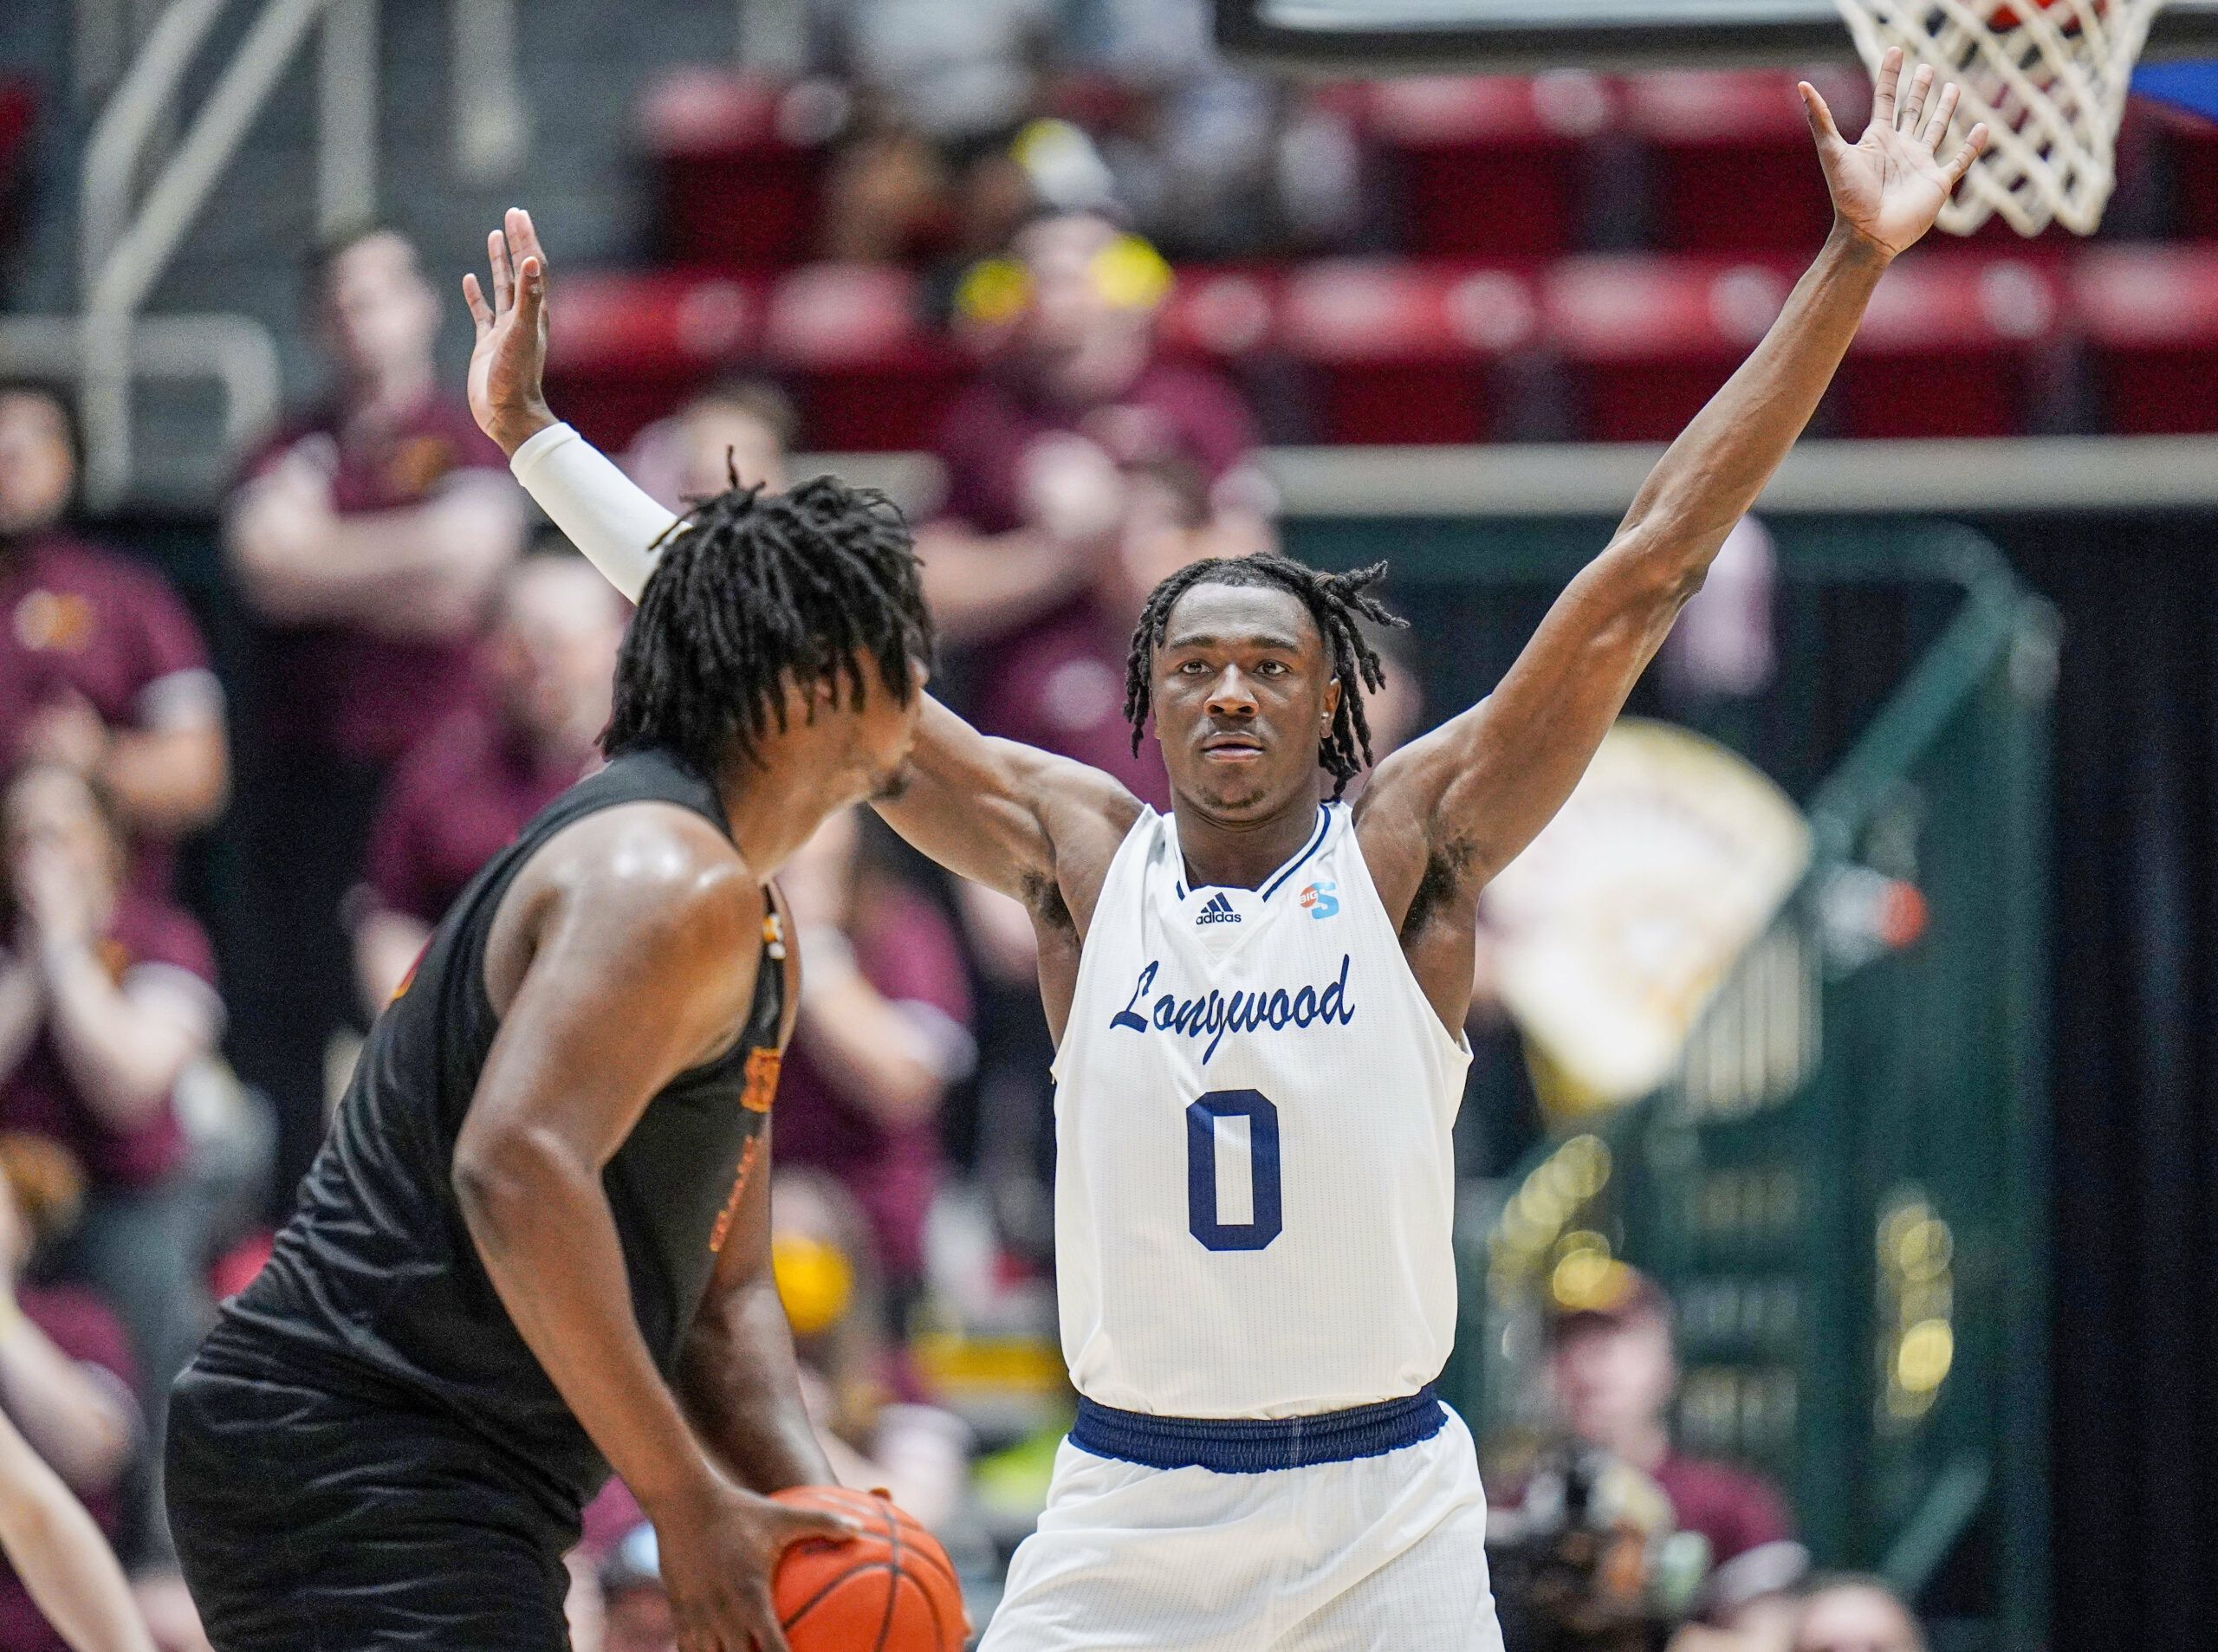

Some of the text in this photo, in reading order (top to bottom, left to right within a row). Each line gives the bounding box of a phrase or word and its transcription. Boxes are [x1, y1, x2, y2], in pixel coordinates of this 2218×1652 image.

[1196, 911, 1242, 925] adidas
[1110, 954, 1356, 1066] Longwood
[1185, 1088, 1283, 1252] 0
